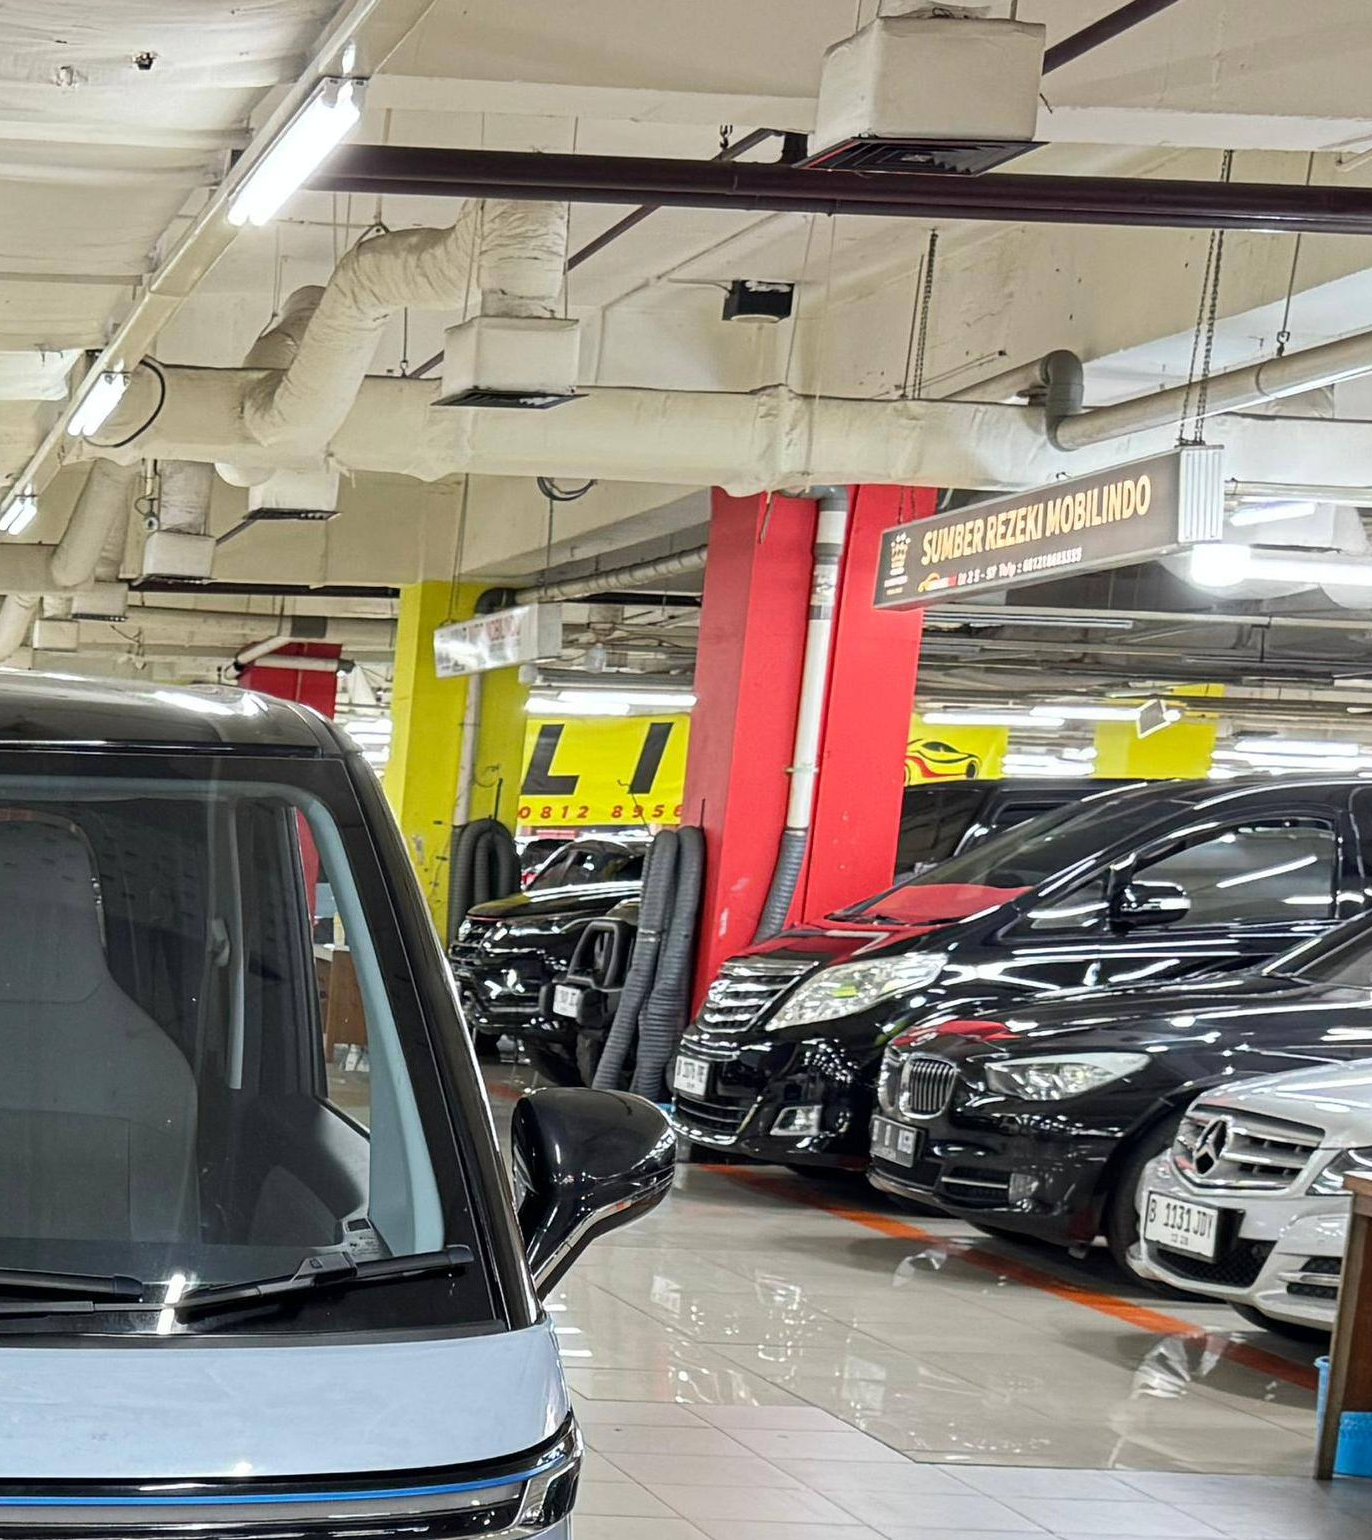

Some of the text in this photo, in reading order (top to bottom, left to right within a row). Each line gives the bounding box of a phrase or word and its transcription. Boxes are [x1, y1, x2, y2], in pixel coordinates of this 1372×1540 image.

[921, 525, 983, 566] SUMBER
[985, 503, 1043, 551] REZEKI
[1045, 475, 1151, 537] MOBILINDO
[518, 806, 589, 819] 0812
